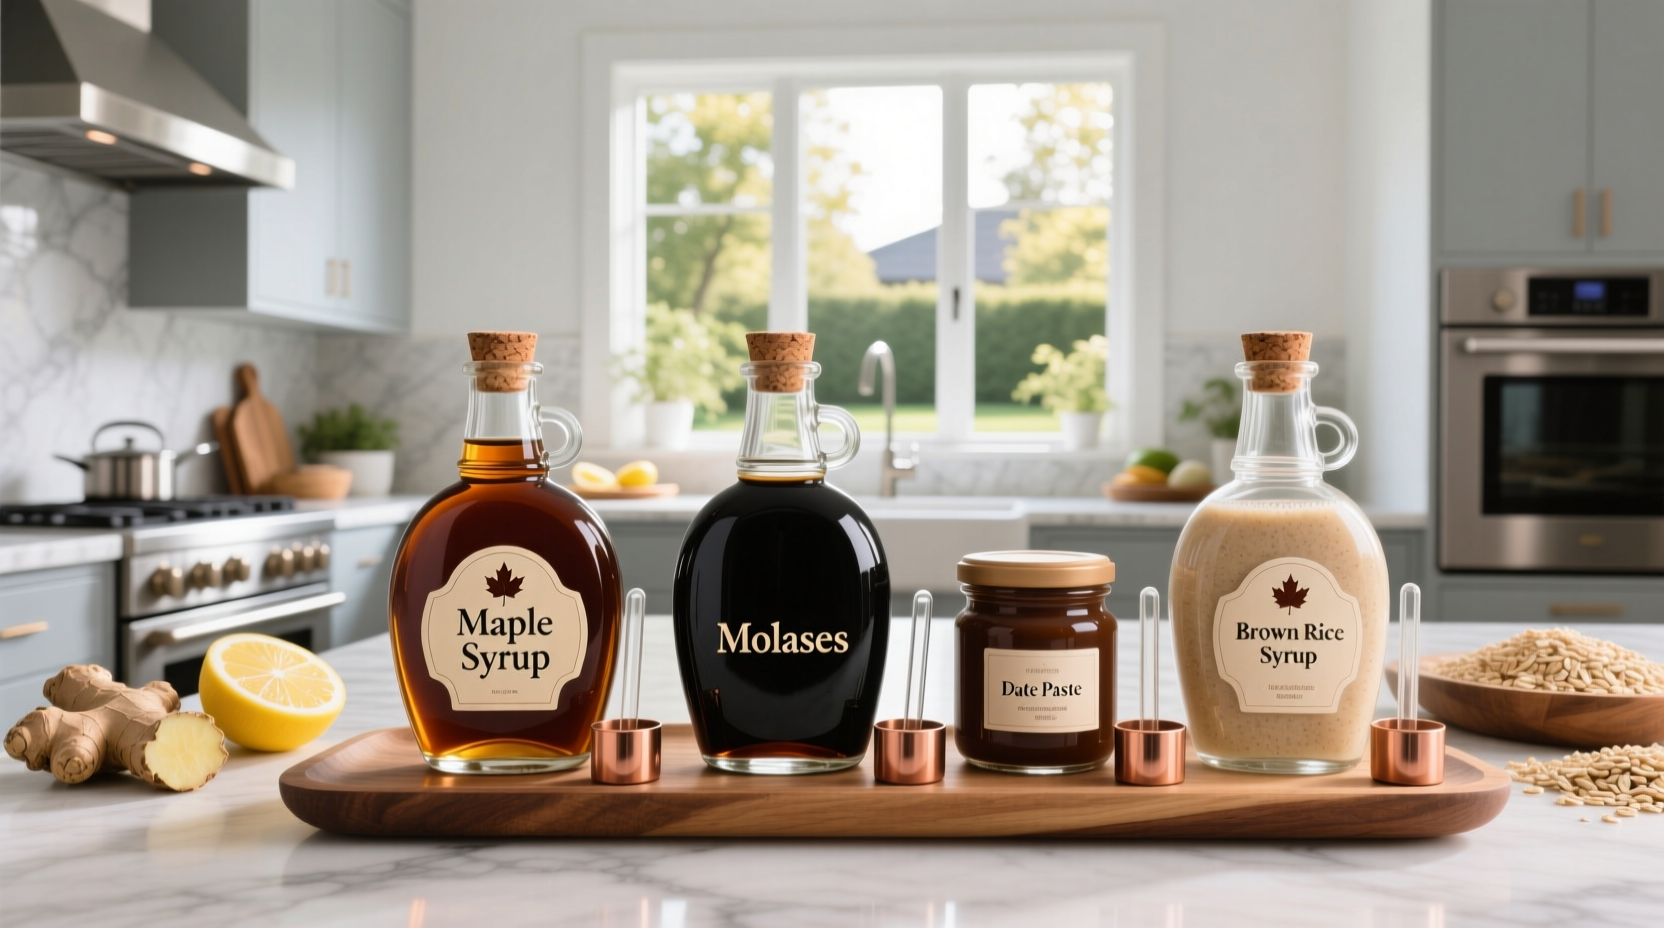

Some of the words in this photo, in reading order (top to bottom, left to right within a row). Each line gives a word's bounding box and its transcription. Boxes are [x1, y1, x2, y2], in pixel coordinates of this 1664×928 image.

[457, 607, 553, 645] Maple
[717, 621, 849, 654] Molases
[1236, 621, 1299, 641] Brown
[1304, 622, 1345, 641] Rice
[461, 642, 550, 680] Syrup
[1260, 645, 1318, 670] Syrup
[1002, 680, 1039, 698] Date
[1042, 681, 1082, 698] Paste
